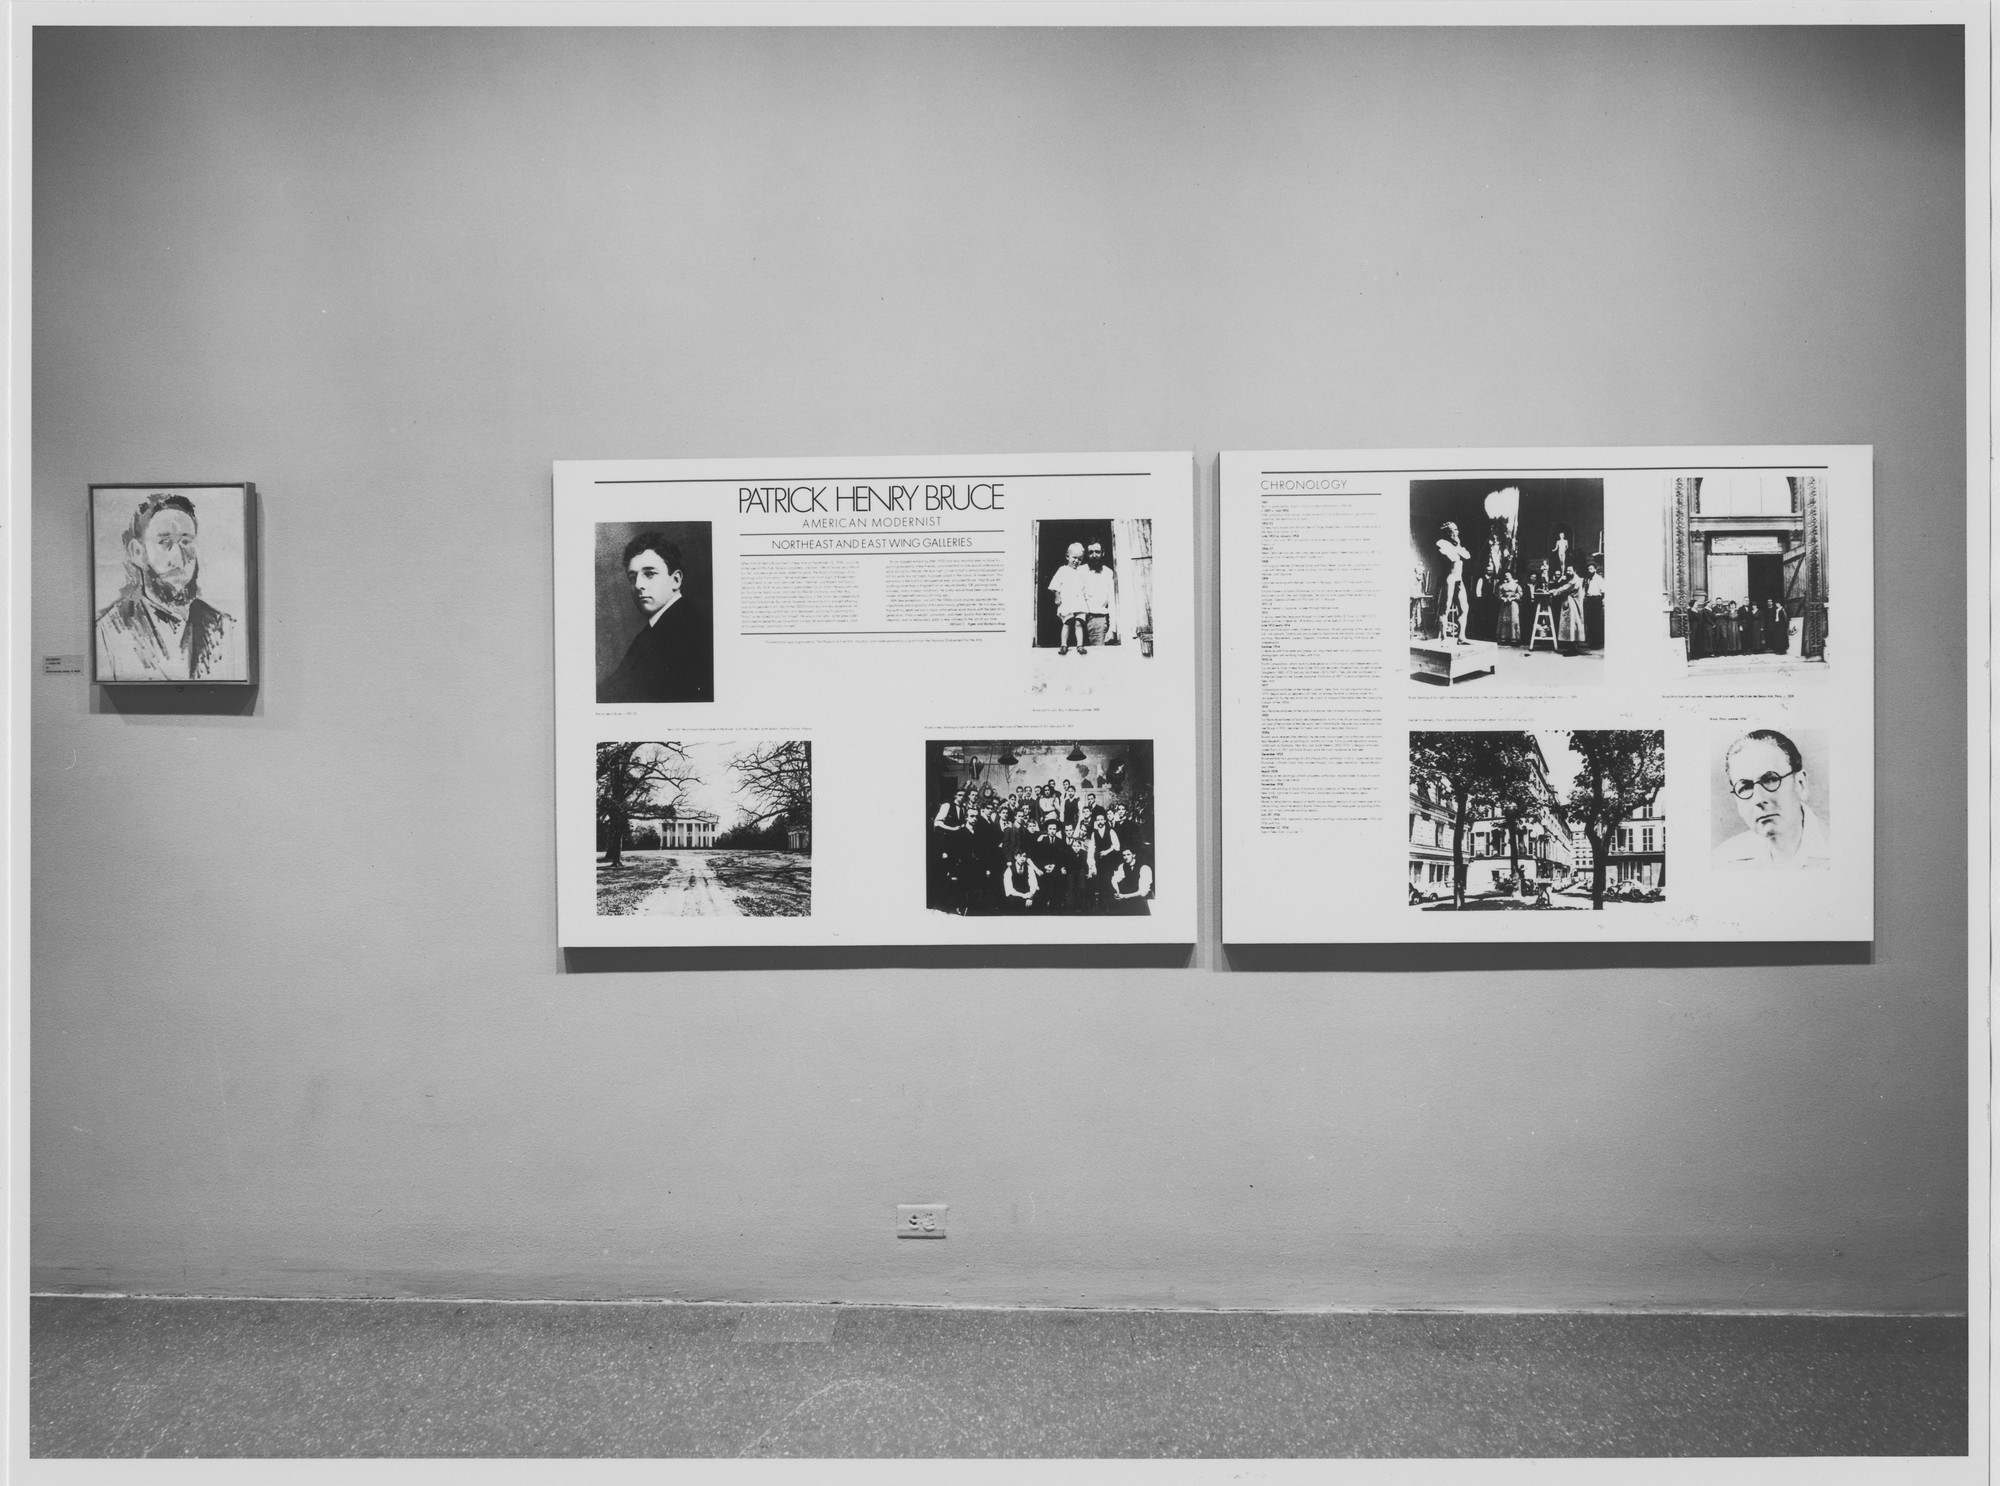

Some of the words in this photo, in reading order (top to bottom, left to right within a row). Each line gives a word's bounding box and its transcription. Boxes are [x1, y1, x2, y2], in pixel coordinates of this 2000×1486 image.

[1261, 480, 1347, 490] CHRONOLOGY
[739, 486, 828, 513] PATRICK
[836, 485, 919, 512] HENRY
[926, 484, 1004, 511] BRUCE
[802, 518, 866, 528] AMERICAN
[872, 517, 941, 527] MODERNIST
[772, 540, 834, 549] NORTHEAST
[836, 539, 859, 548] AND
[862, 539, 886, 548] EAST
[889, 538, 920, 548] WING
[923, 537, 972, 547] GALLERIES
